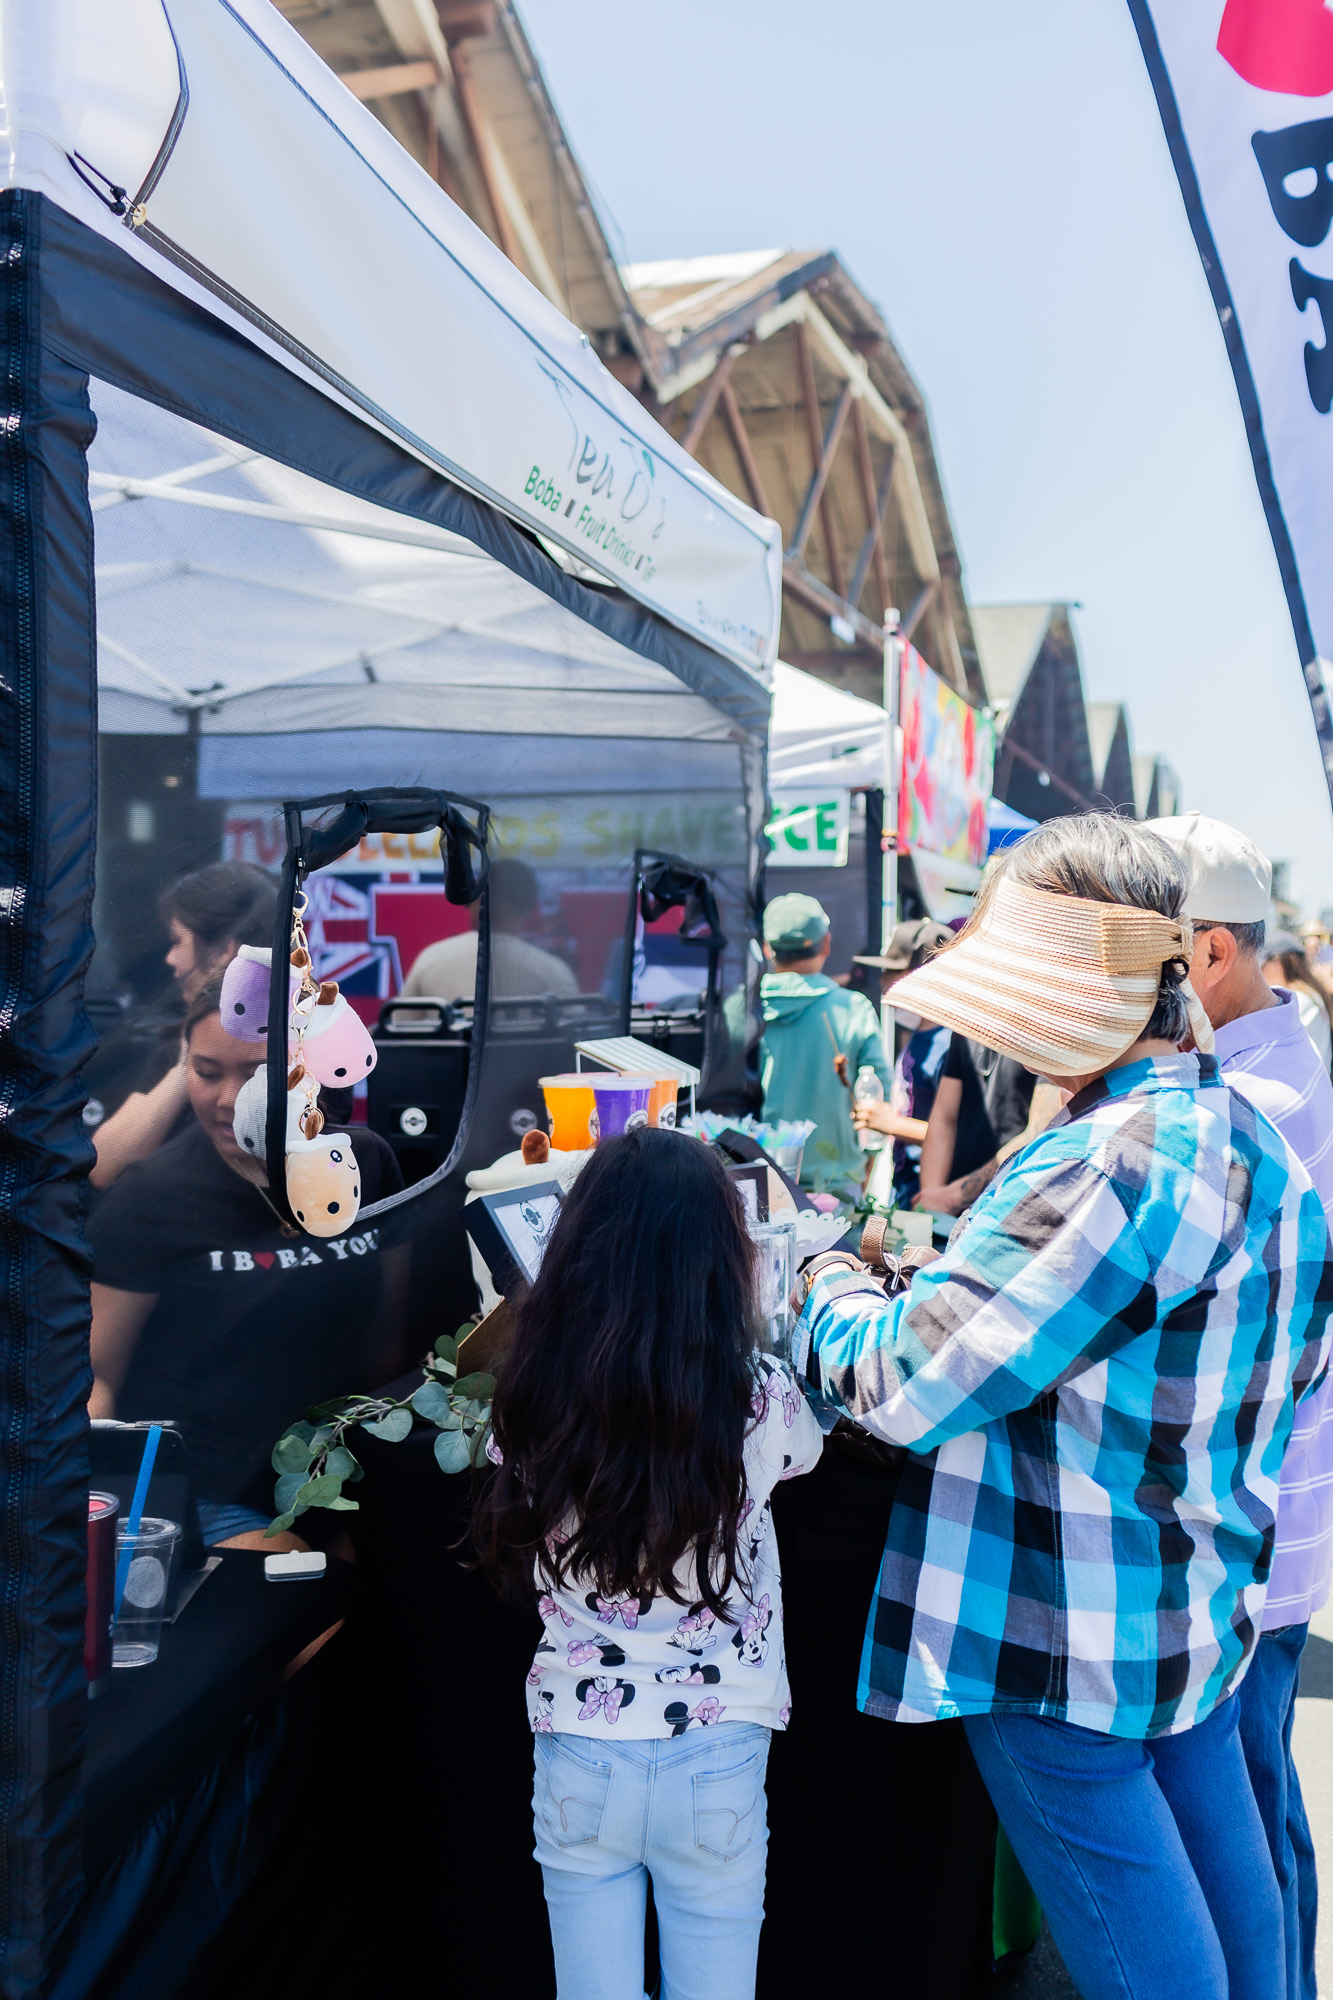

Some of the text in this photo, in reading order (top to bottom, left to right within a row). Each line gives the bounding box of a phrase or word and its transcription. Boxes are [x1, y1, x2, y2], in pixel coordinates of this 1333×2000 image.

[524, 465, 562, 512] Boba
[575, 505, 607, 545] Fruit
[602, 526, 637, 567] Drinks
[581, 805, 736, 857] SHAVE
[209, 1250, 224, 1271] I
[327, 1228, 379, 1260] YOU
